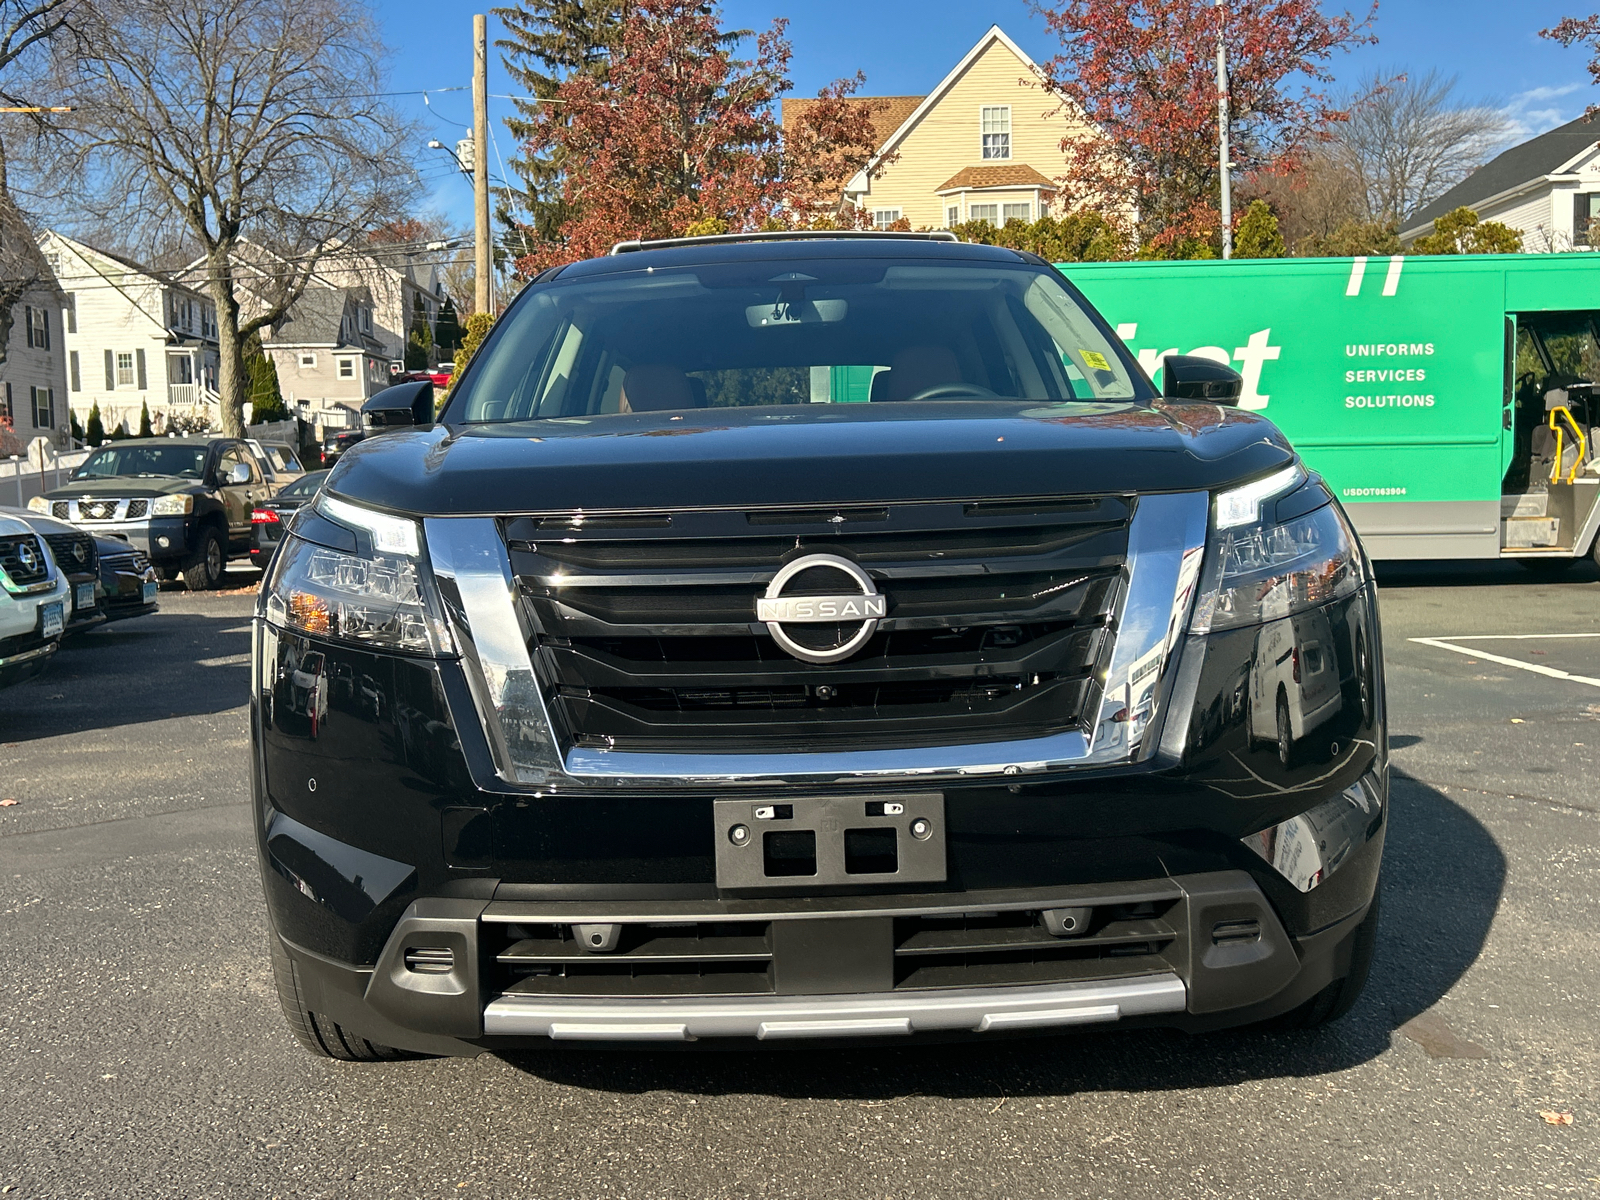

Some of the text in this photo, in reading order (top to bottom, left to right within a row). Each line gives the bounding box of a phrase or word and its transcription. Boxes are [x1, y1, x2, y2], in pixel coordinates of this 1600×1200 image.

[1345, 343, 1435, 357] UNIFORMS
[1345, 368, 1426, 383] SERVICES
[1345, 394, 1435, 408] SOLUTIONS
[1343, 487, 1406, 496] USDOT063904
[760, 599, 883, 618] NISSAN
